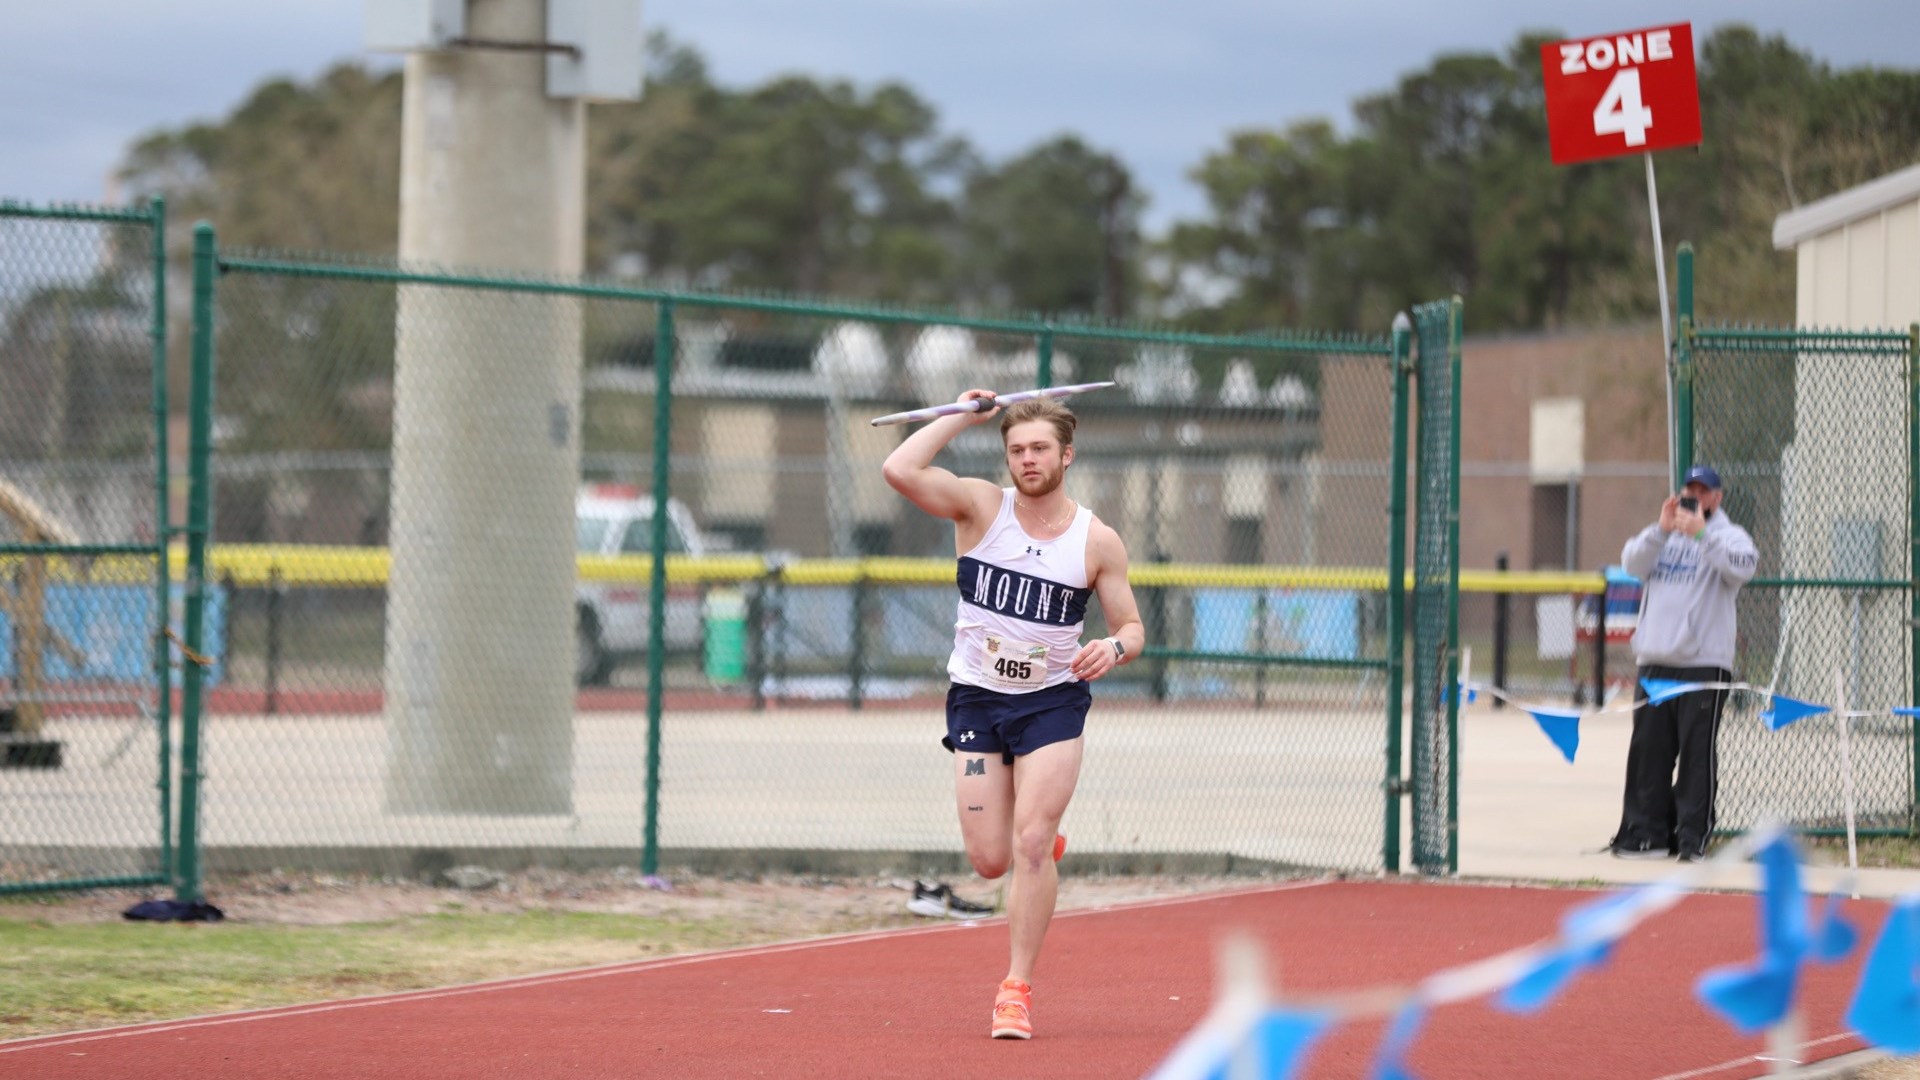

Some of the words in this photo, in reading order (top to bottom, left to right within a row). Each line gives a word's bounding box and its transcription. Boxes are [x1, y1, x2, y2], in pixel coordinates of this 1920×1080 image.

[1560, 29, 1673, 75] ZONE
[1593, 67, 1653, 147] 4
[974, 564, 1074, 623] MOUNT
[994, 657, 1032, 680] 465
[964, 758, 986, 776] M
